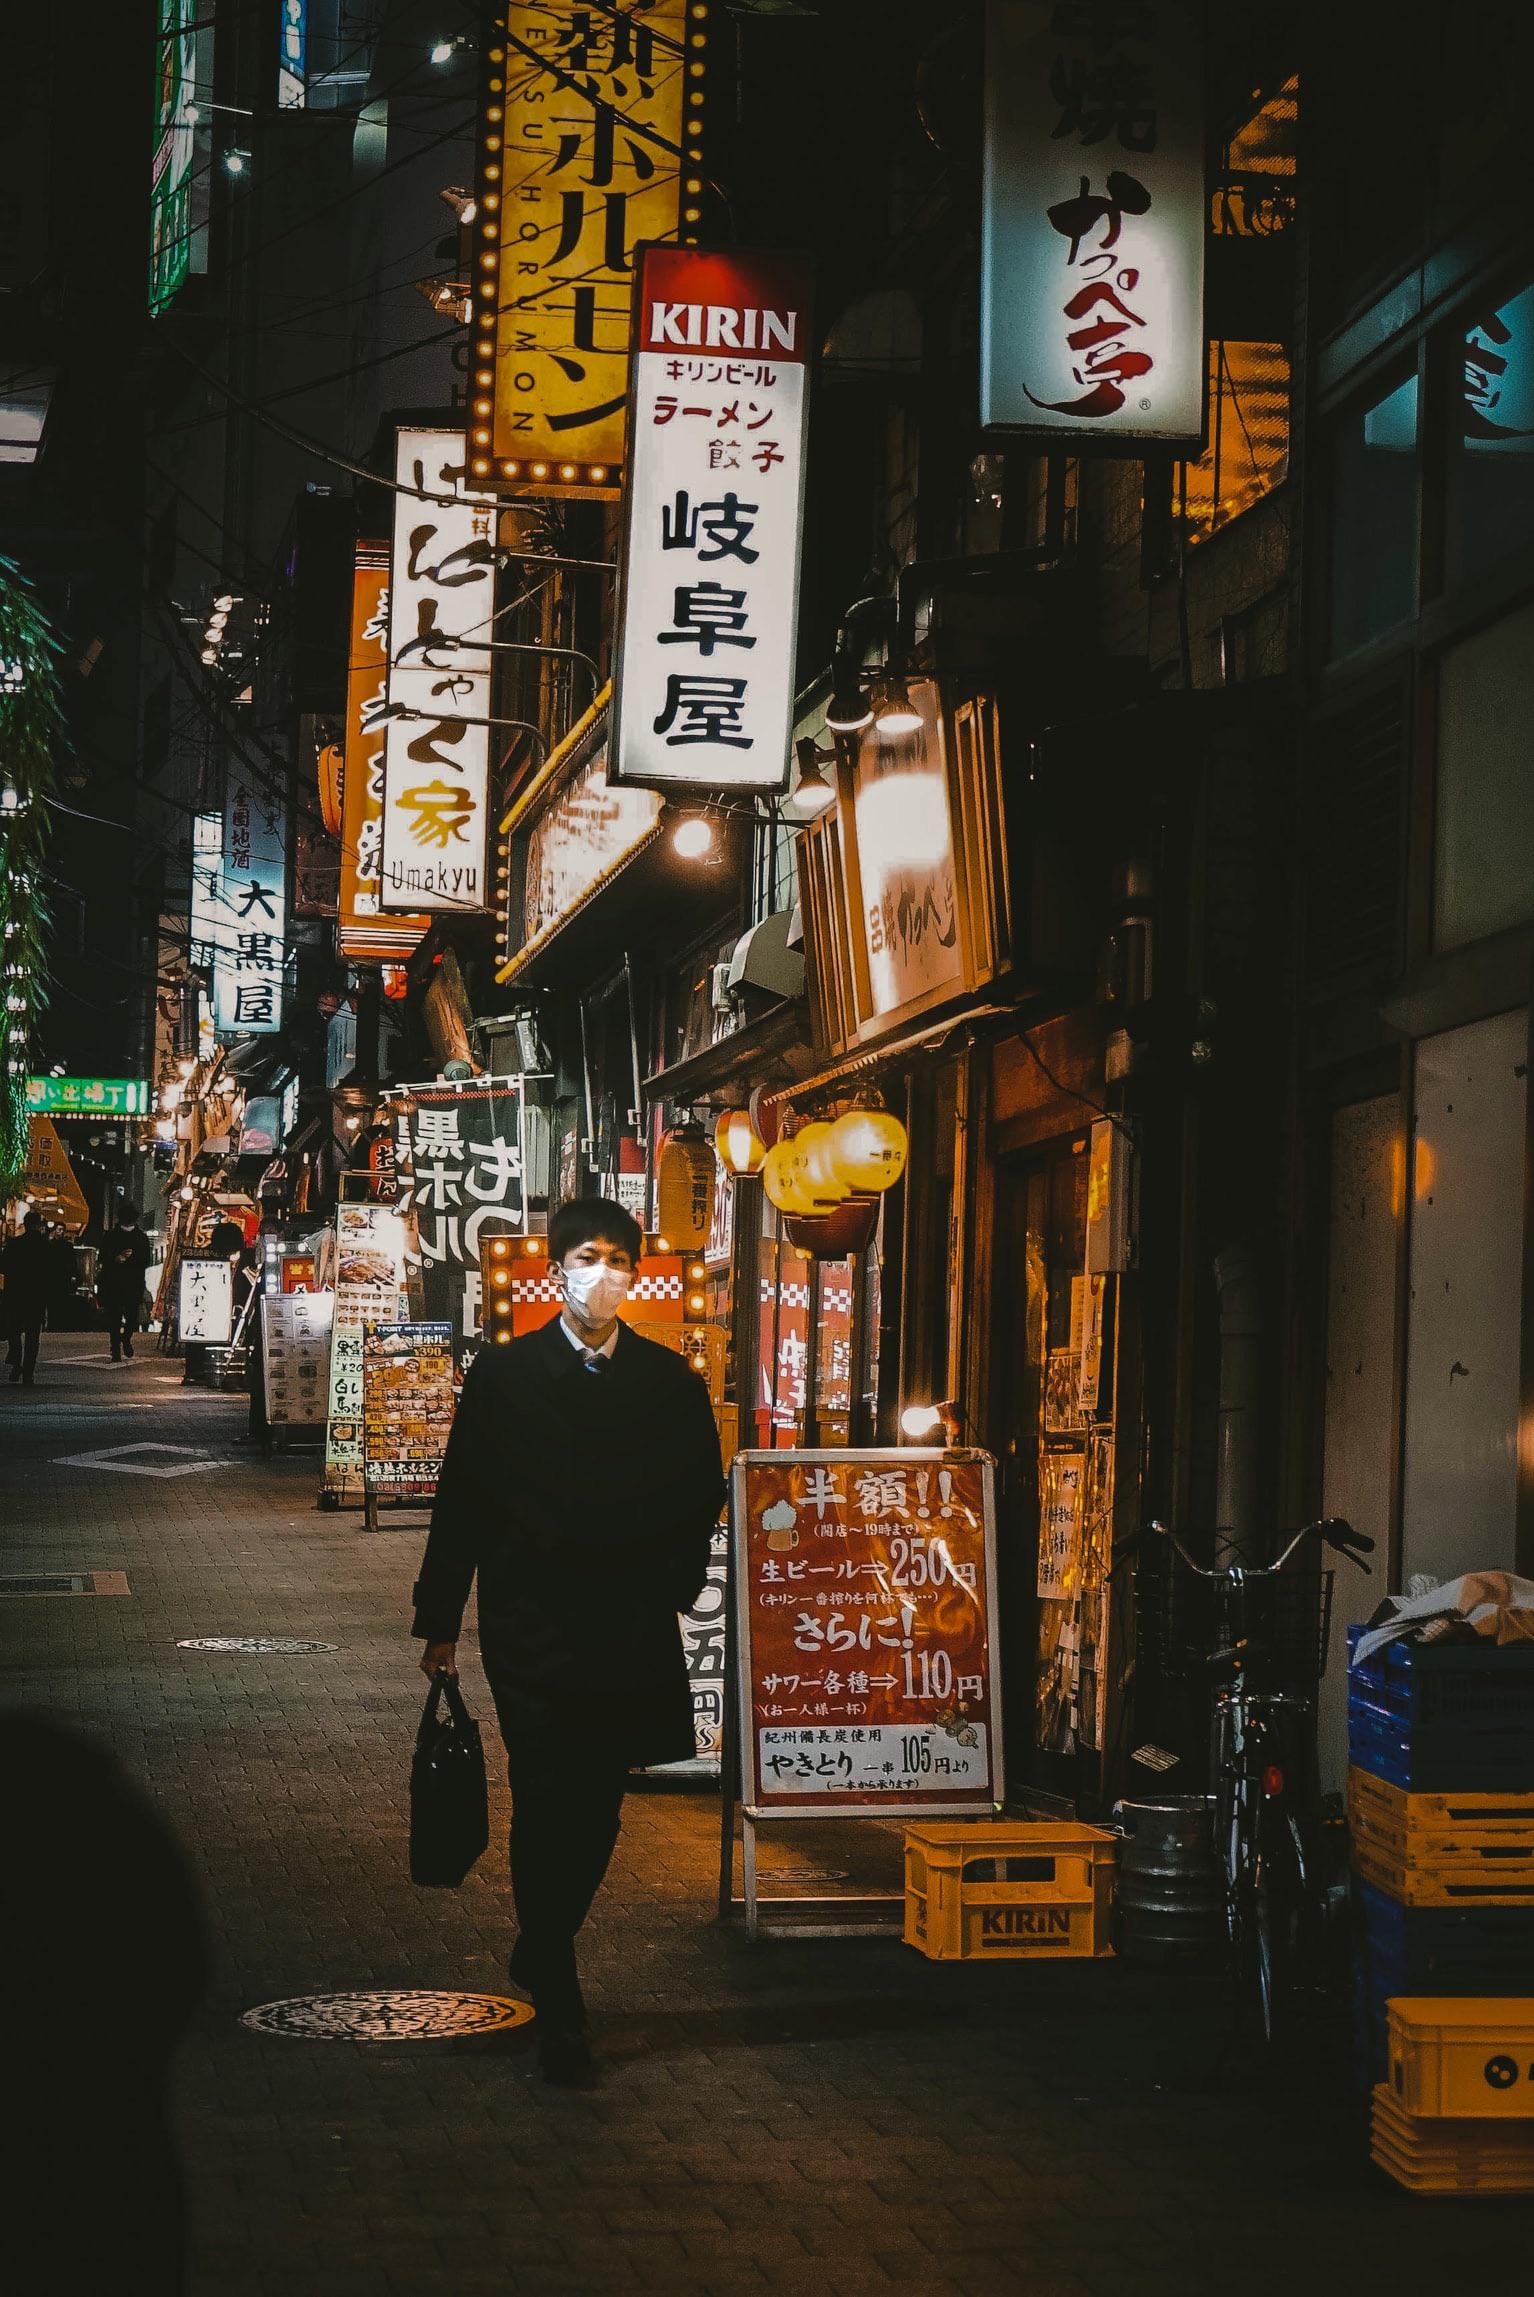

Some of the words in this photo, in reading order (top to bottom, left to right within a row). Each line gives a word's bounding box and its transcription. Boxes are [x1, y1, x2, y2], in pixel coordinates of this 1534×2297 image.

[650, 302, 798, 351] KIRIN
[667, 360, 777, 387] キリンビール
[653, 396, 774, 430] ラーメン
[708, 438, 785, 473] 餃子
[653, 490, 760, 750] 岐阜屋
[233, 879, 277, 1025] 大黒屋
[796, 1468, 953, 1520] 半額!!
[792, 1606, 915, 1652] さらに!
[761, 1669, 870, 1696] サワー各種
[901, 1649, 984, 1701] 110円
[764, 1729, 882, 1745] 紀州備長炭使用
[764, 1750, 854, 1779] やきとり
[982, 1909, 1070, 1934] KIRIN
